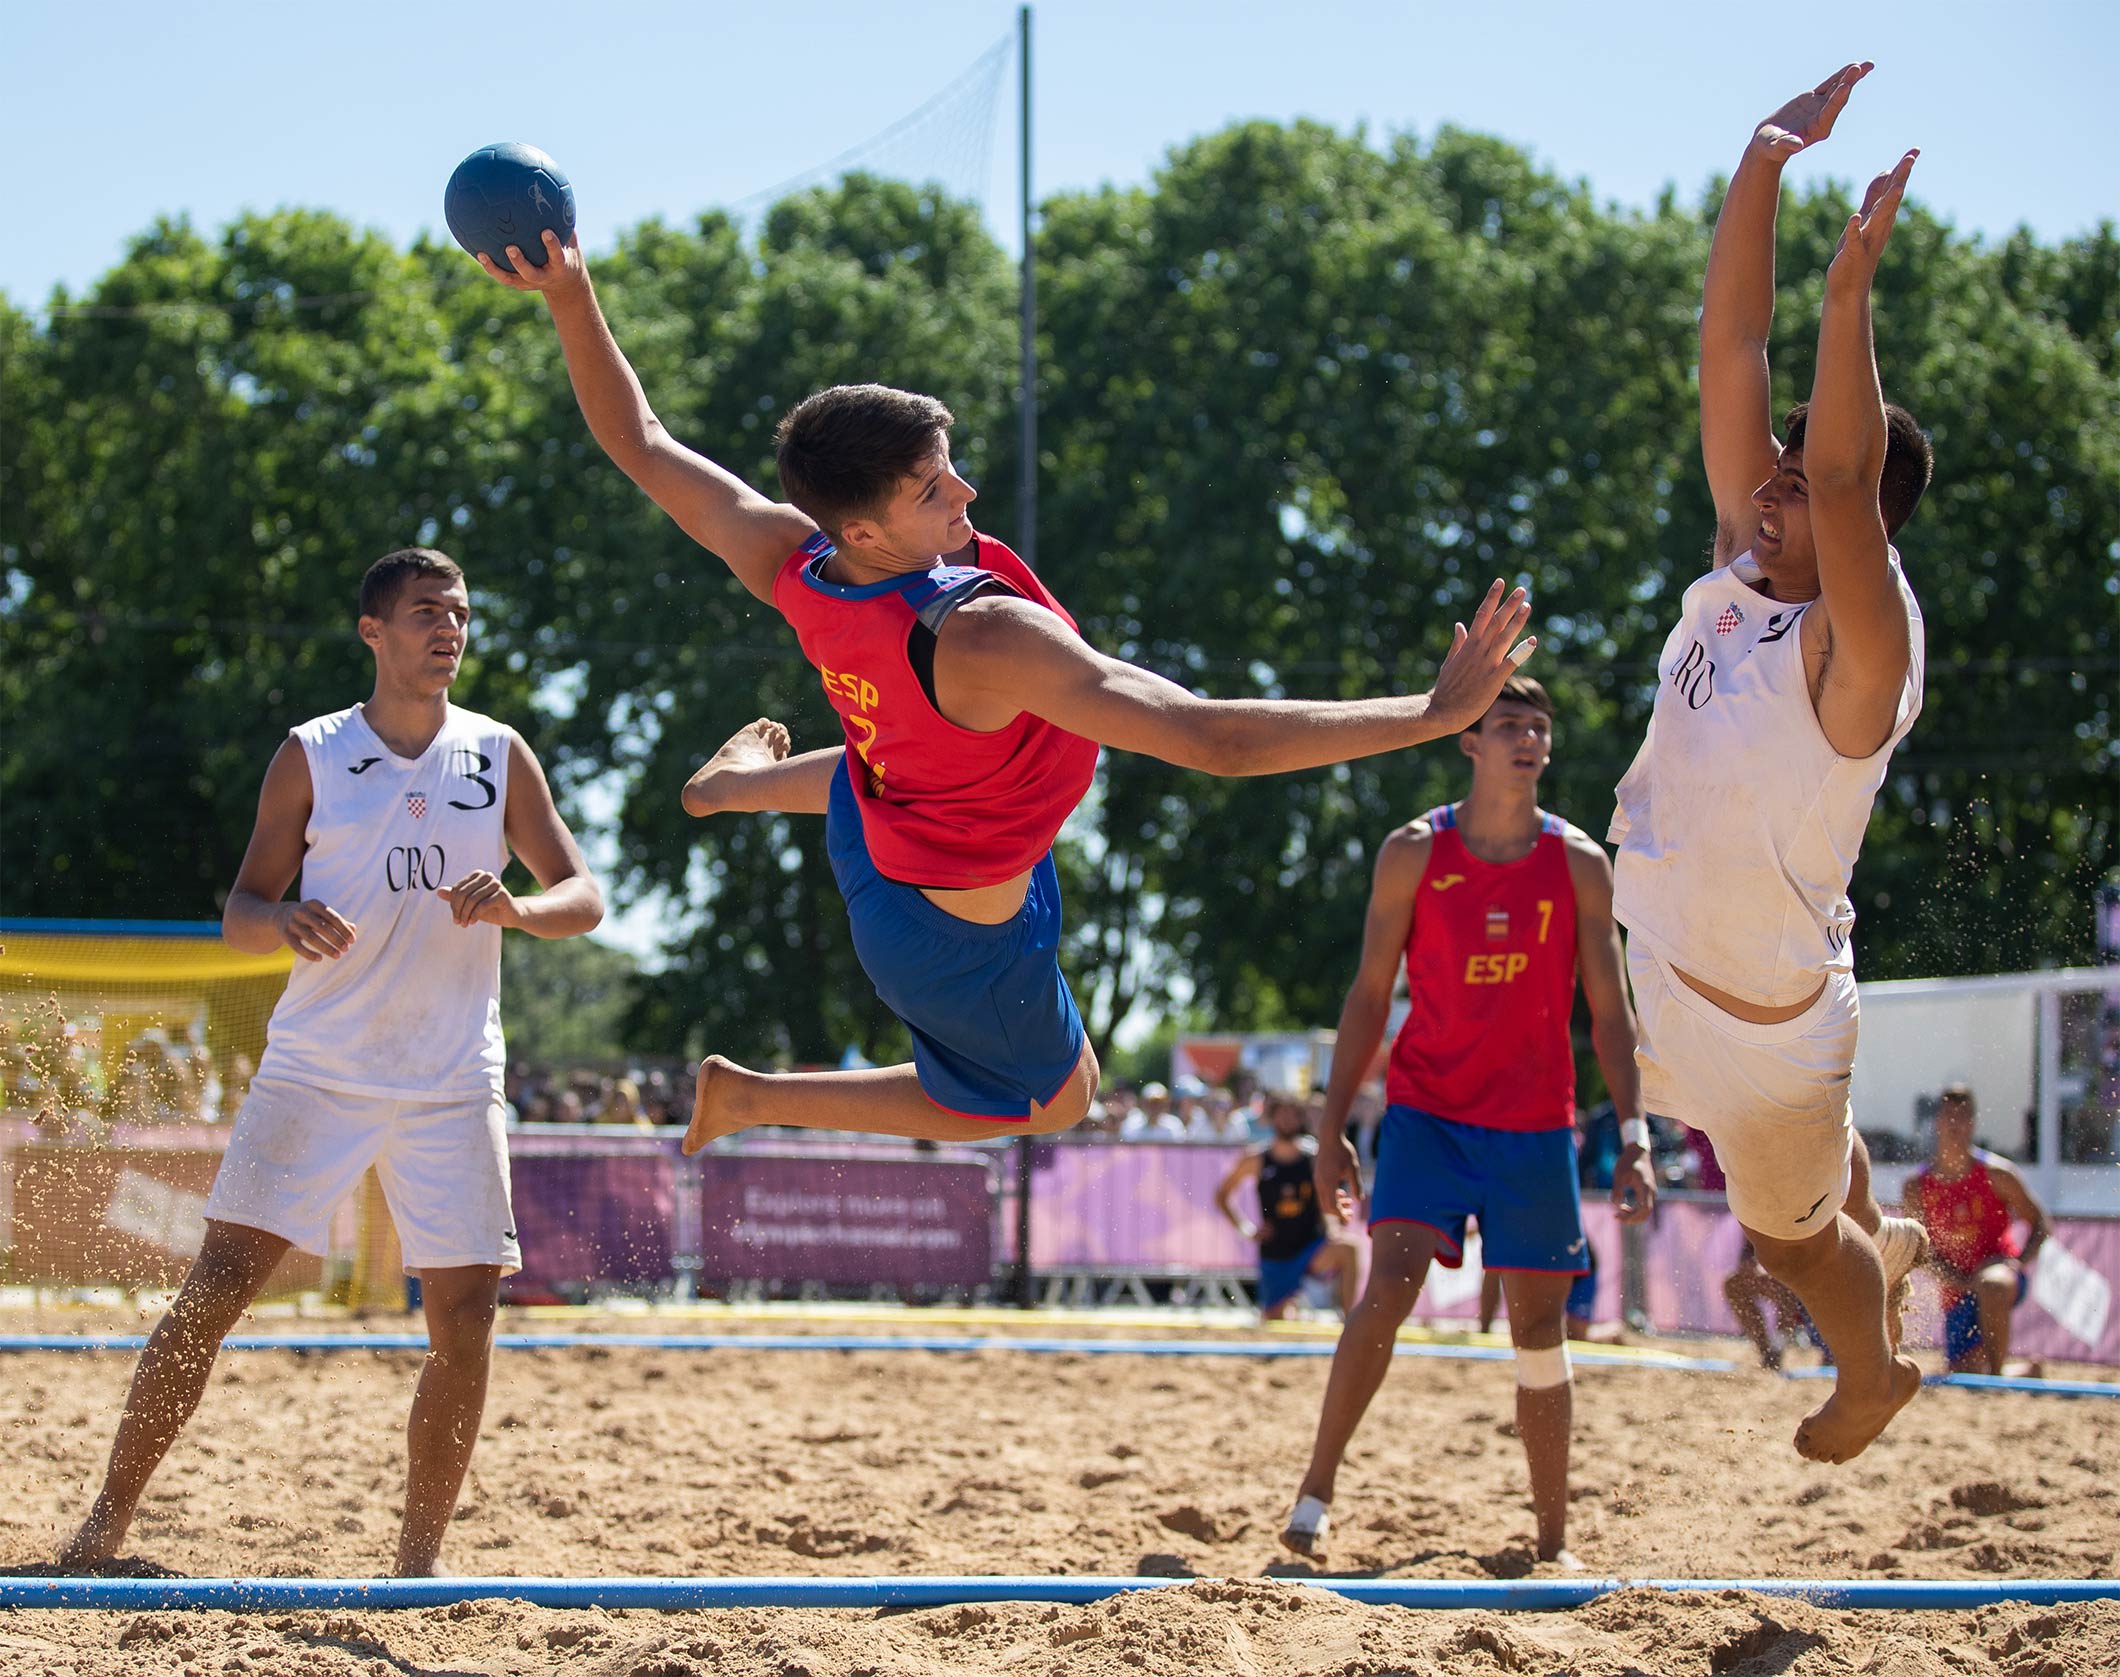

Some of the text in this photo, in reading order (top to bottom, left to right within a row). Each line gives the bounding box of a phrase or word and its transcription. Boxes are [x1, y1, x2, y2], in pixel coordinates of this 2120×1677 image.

[820, 663, 880, 713] ESP
[447, 749, 497, 810] 3
[386, 844, 446, 893] CRO
[1537, 899, 1554, 945] 7
[1464, 952, 1530, 985] ESP
